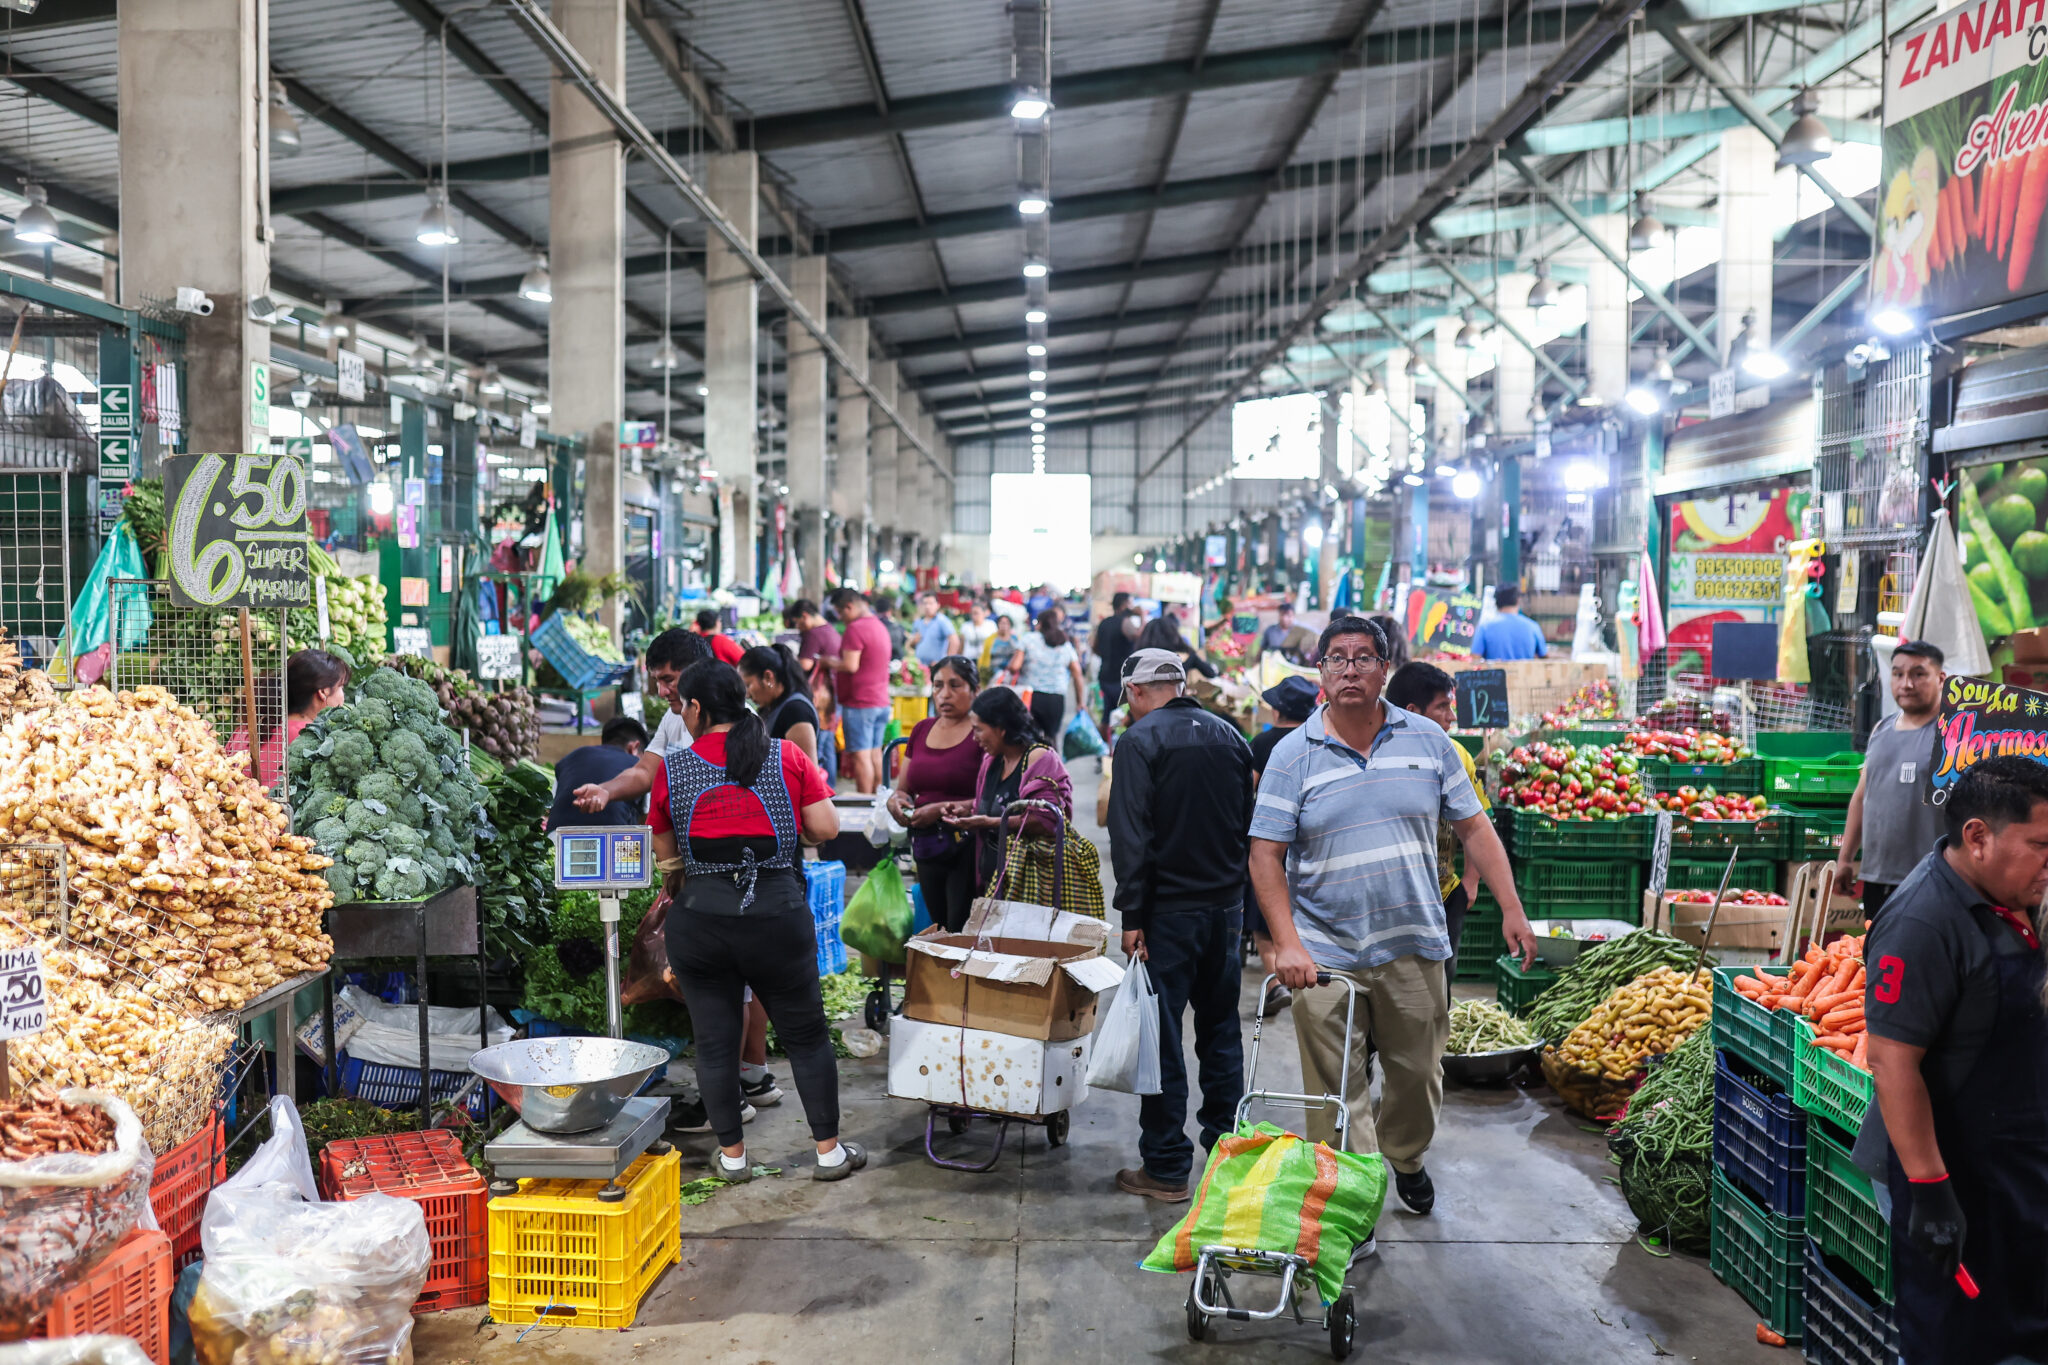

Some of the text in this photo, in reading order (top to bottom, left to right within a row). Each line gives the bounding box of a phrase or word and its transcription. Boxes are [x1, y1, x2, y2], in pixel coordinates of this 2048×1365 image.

[102, 417, 128, 426] SALIDA
[102, 467, 128, 477] ENTRADA
[245, 541, 309, 573] SUPER
[1937, 711, 2048, 777] Hermos
[1875, 955, 1905, 1003] 3
[13, 1013, 42, 1032] KILO
